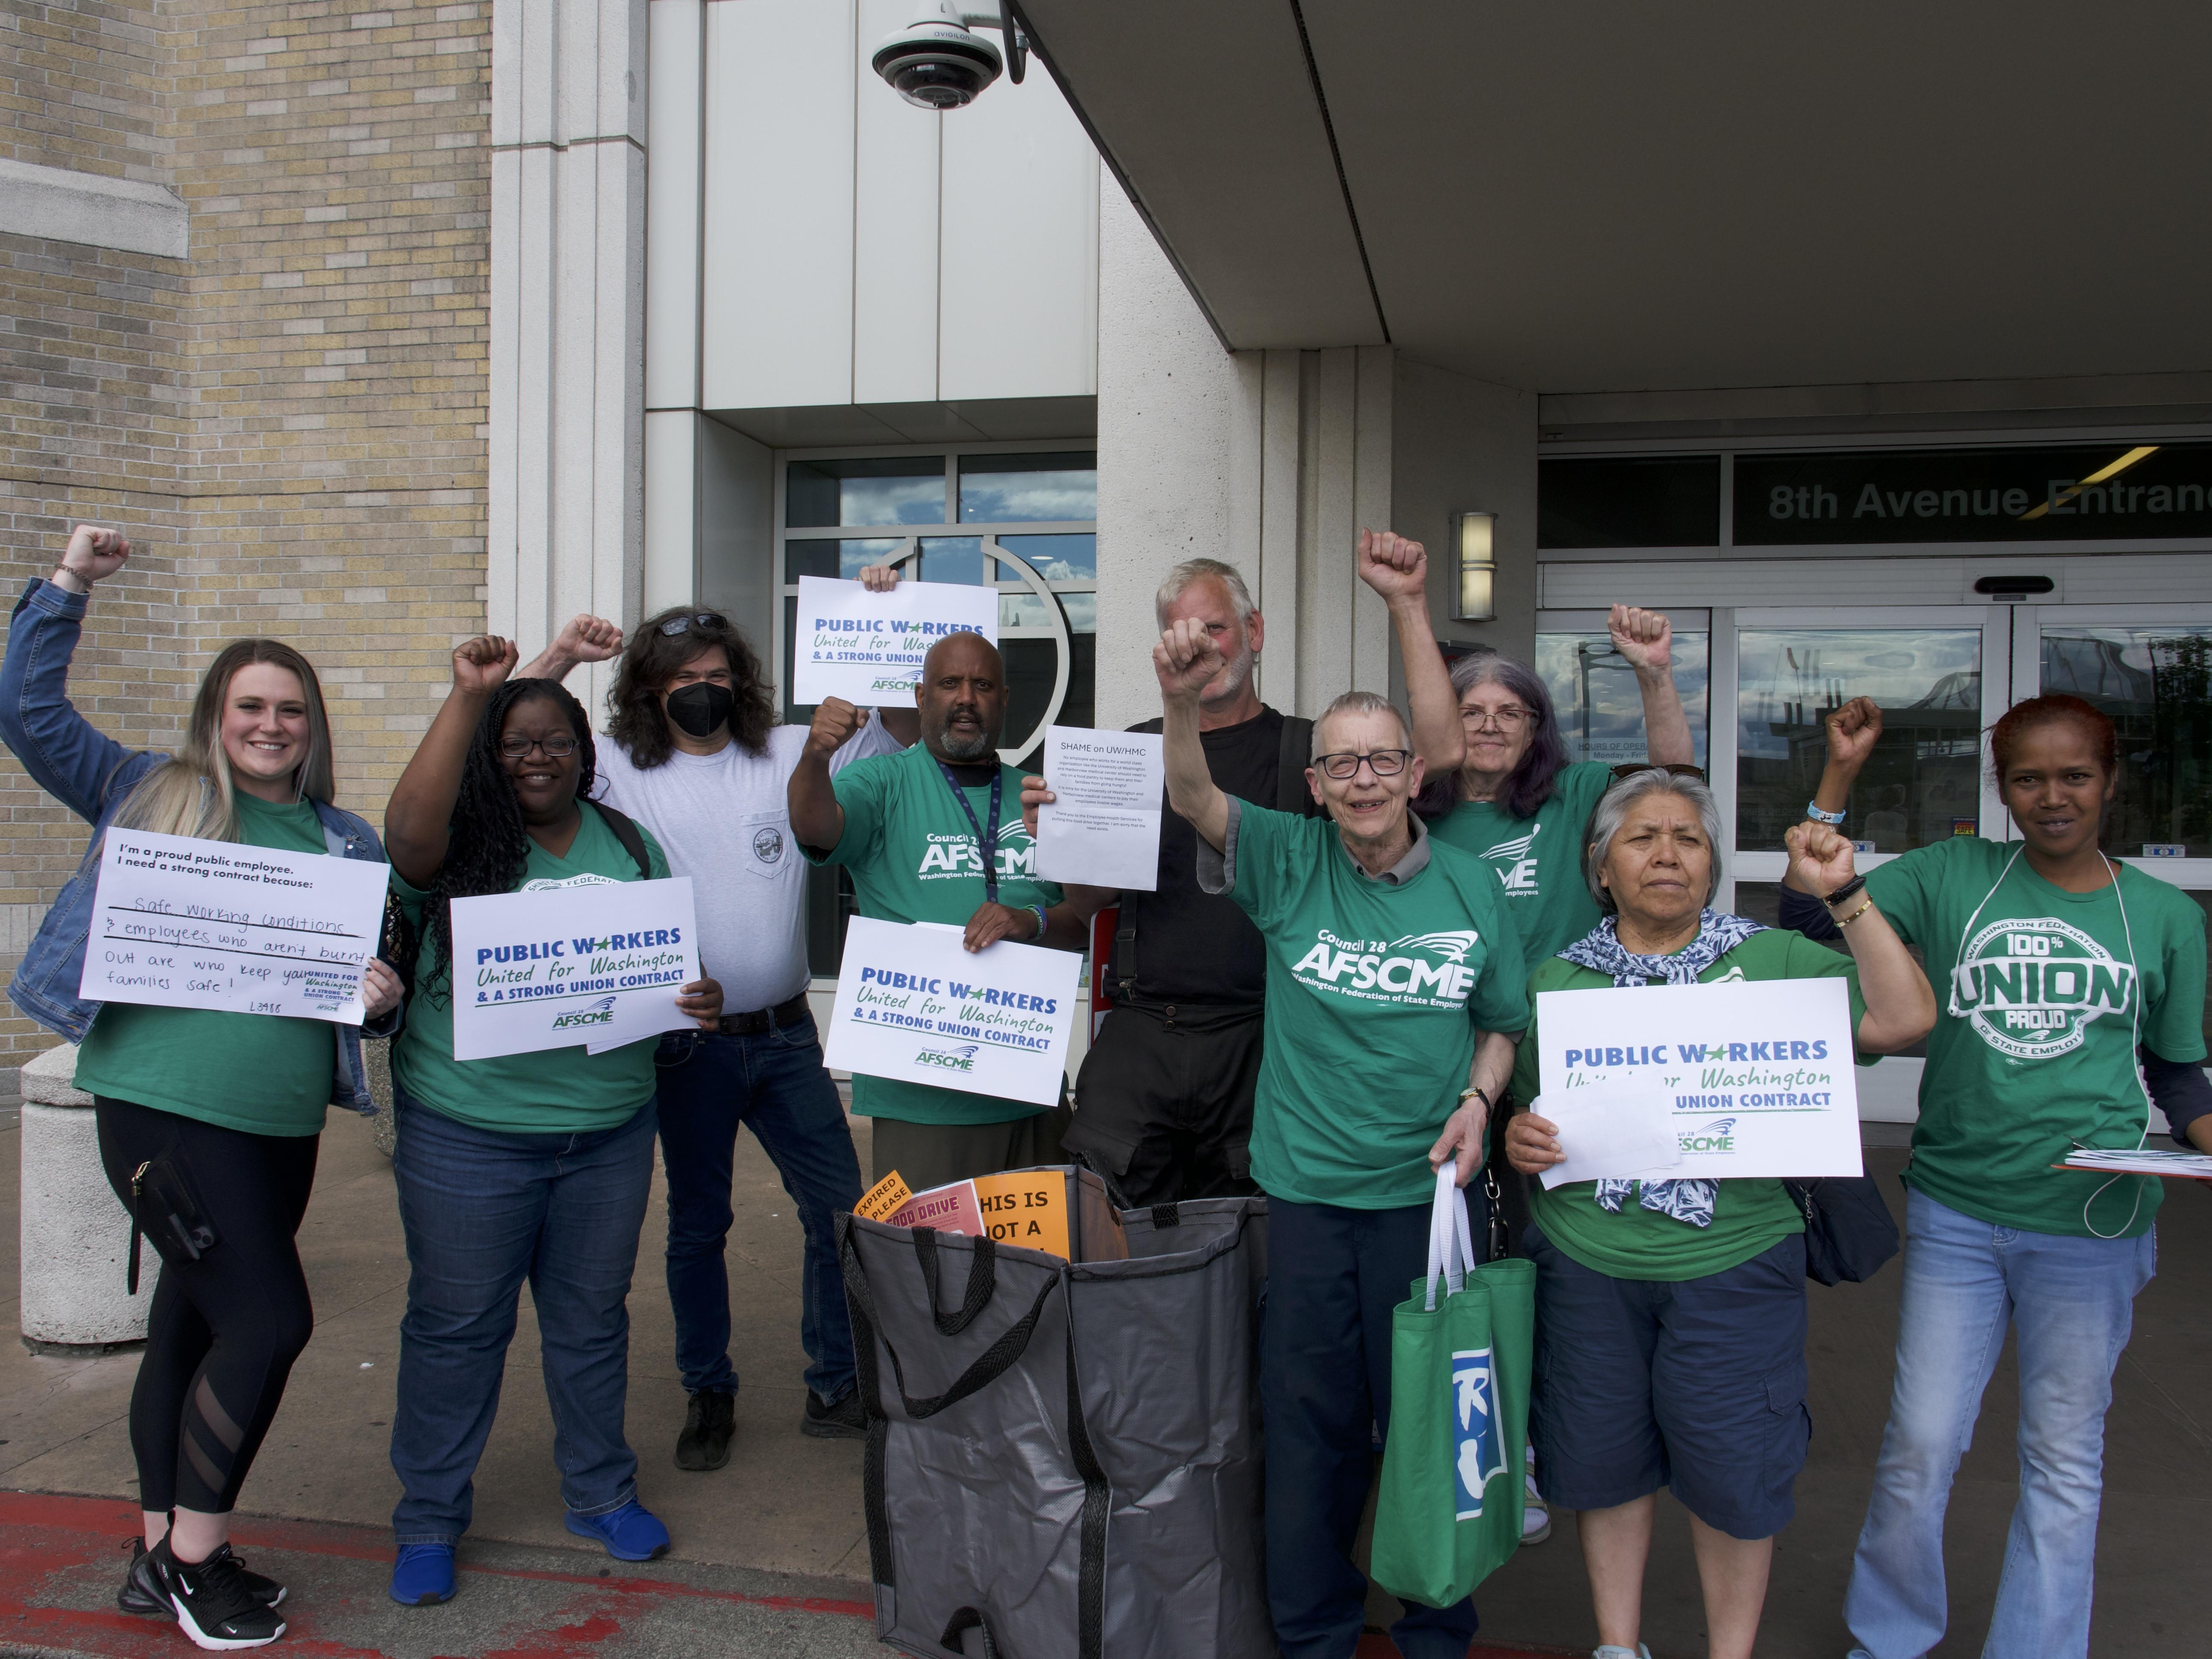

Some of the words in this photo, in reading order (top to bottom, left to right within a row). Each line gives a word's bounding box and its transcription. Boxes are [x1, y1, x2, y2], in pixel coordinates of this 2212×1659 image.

[1770, 484, 1837, 518] 8th
[1852, 483, 2029, 518] Avenue
[2048, 479, 2212, 514] Entran
[815, 619, 883, 633] PUBLIC
[814, 634, 859, 648] United
[870, 635, 890, 649] for
[813, 651, 821, 659] &
[826, 652, 833, 660] A
[837, 652, 882, 661] STRONG
[886, 654, 923, 663] UNION
[871, 680, 916, 690] AFSCM
[1061, 742, 1091, 752] SHAME
[1106, 746, 1146, 756] UW/HMC
[926, 833, 969, 843] Council
[971, 837, 980, 845] 2
[120, 844, 139, 854] I'm
[154, 850, 192, 861] proud
[195, 855, 230, 867] public
[234, 860, 294, 874] employee.
[918, 844, 1037, 874] AFSCM
[117, 856, 122, 864] I
[126, 859, 156, 869] need
[171, 864, 210, 877] strong
[213, 870, 260, 882] contract
[263, 874, 313, 888] because:
[568, 876, 615, 886] FEDERAT
[919, 872, 962, 880] Washington
[136, 897, 172, 914] Safe
[125, 924, 210, 947] employees
[219, 934, 247, 947] who
[265, 942, 307, 957] aren't
[320, 946, 365, 963] burnt
[477, 940, 564, 965] PUBLIC
[1317, 929, 1364, 952] Council
[1368, 941, 1387, 953] 28
[1967, 922, 2034, 960] WASHINGTON
[2038, 922, 2106, 959] FEDERATION
[107, 971, 169, 989] families
[148, 957, 175, 968] are
[194, 961, 225, 971] who
[241, 964, 271, 981] keep
[309, 971, 339, 979] UNITED
[477, 965, 536, 987] United
[549, 961, 574, 981] for
[590, 952, 684, 976] Washington
[861, 967, 941, 995] PUBLIC
[1291, 943, 1475, 999] AFSCME
[306, 978, 358, 990] Washington
[477, 992, 488, 1002] &
[494, 989, 504, 1001] A
[509, 983, 565, 999] STRONG
[570, 980, 615, 992] UNION
[620, 969, 684, 987] CONTRACT
[1291, 972, 1339, 992] Washington
[1341, 987, 1390, 1001] Federation
[1403, 995, 1428, 1005] State
[1430, 998, 1464, 1009] Employe
[1956, 962, 2131, 1010] UNION
[552, 1010, 614, 1028] AFSCME
[857, 986, 911, 1009] United
[920, 997, 946, 1015] for
[959, 1004, 1054, 1034] Washington
[2005, 1010, 2066, 1029] PROUD
[854, 1007, 863, 1018] &
[868, 1010, 877, 1020] A
[882, 1012, 933, 1029] STRONG
[938, 1022, 980, 1038] UNION
[984, 1030, 1051, 1050] CONTRACT
[1979, 1025, 1991, 1037] OF
[1991, 1036, 2027, 1054] STATE
[915, 1052, 974, 1071] AFSCME
[1566, 1045, 1667, 1068] PUBLIC
[1701, 1066, 1831, 1091] Washington
[1676, 1094, 1733, 1109] UNION
[1740, 1093, 1831, 1107] CONTRACT
[1679, 1137, 1734, 1151] SCME
[858, 1178, 896, 1216] EXPIRED
[872, 1187, 908, 1220] PLEASE
[917, 1196, 960, 1220] DRIVE
[979, 1194, 1016, 1213] HIS
[1025, 1192, 1048, 1207] IS
[1027, 1220, 1041, 1236] A
